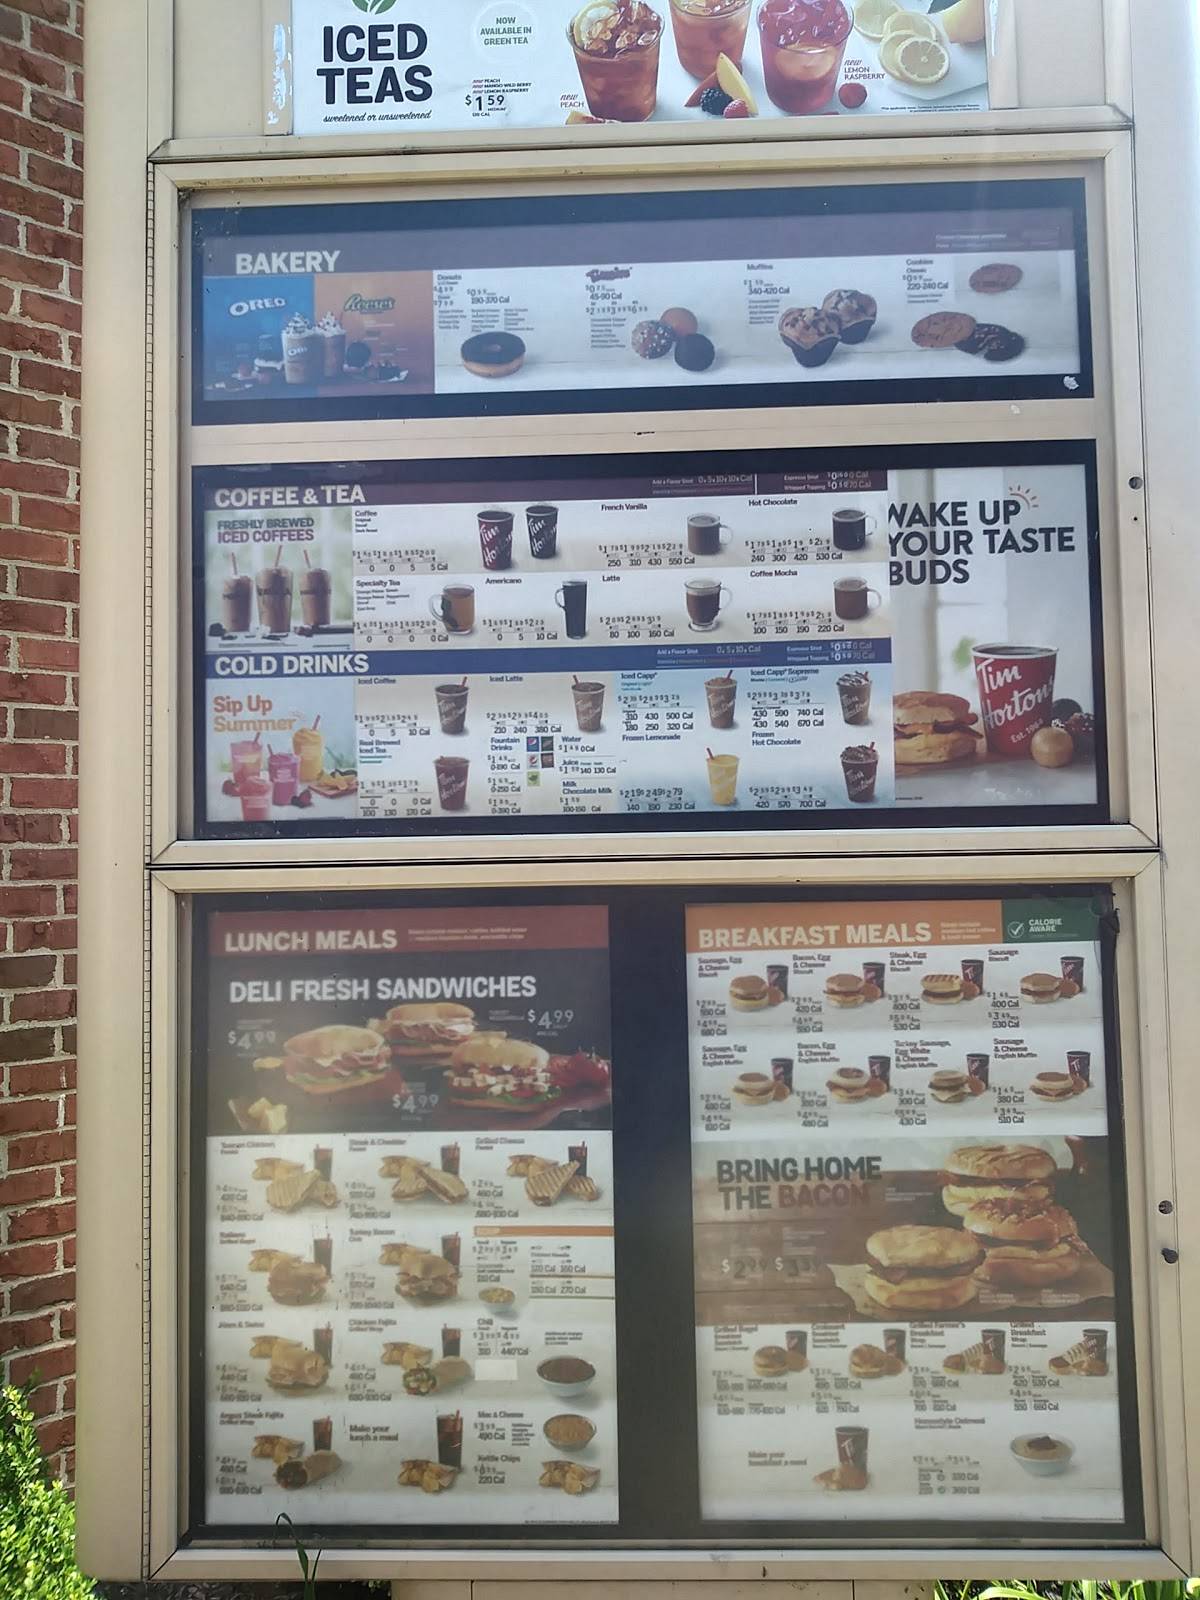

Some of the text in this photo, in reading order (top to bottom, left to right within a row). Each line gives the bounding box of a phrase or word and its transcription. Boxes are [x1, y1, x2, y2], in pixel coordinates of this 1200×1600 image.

[496, 17, 516, 25] NOW
[480, 26, 532, 35] AVAILABLE IN
[323, 23, 428, 63] ICED
[483, 37, 512, 46] GREEN
[316, 64, 433, 105] TEAS
[323, 109, 432, 123] sweetened or unsweetened
[236, 250, 341, 275] BAKERY
[229, 296, 287, 317] OREO
[214, 484, 366, 508] COFFEE & TEA
[601, 503, 624, 511] French
[979, 499, 1021, 525] UP
[217, 517, 315, 530] FRESHLY BREWED
[217, 529, 314, 544] ICED COFFEES
[888, 526, 1075, 557] YOUR TASTE
[750, 569, 798, 578] Coffee Mocha
[889, 558, 970, 586] BUDS
[753, 626, 767, 634] 100
[833, 624, 845, 632] Cal
[214, 654, 370, 676] COLD DRINKS
[977, 657, 1022, 694] Tim
[213, 694, 273, 717] Sip Up
[812, 708, 824, 716] Cal
[645, 712, 659, 720] 430
[681, 711, 693, 719] Cal
[213, 716, 297, 733] Summer
[666, 722, 681, 730] 320
[682, 722, 694, 730] Cal
[753, 720, 768, 728] 430
[622, 733, 681, 742] Frozen Lemonade
[766, 738, 801, 746] Chocolate
[562, 787, 597, 795] Chocolate
[1027, 918, 1063, 926] CALORIE
[225, 931, 309, 952] LUNCH
[316, 929, 398, 950] MEALS
[699, 926, 840, 950] BREAKFAST
[845, 922, 933, 945] MEALS
[229, 976, 537, 1003] DELI FRESH SANDWICHES
[716, 1156, 883, 1184] BRING HOME
[718, 1185, 773, 1211] THE
[778, 1183, 871, 1209] BACON
